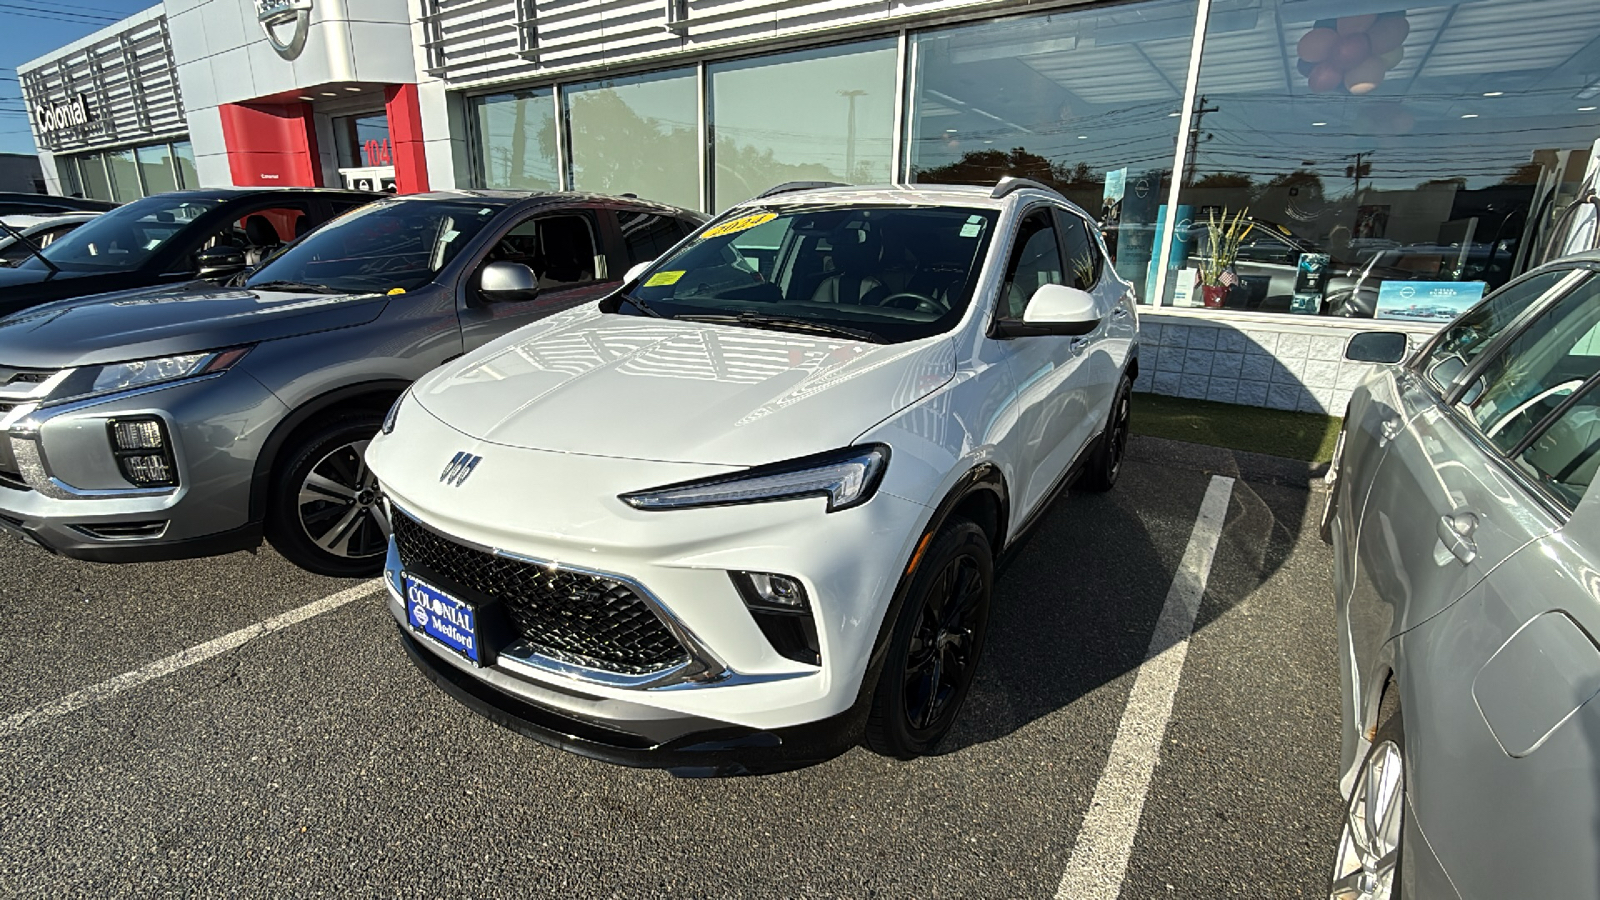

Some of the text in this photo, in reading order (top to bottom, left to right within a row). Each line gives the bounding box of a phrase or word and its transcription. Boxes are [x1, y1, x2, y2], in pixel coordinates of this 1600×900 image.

[36, 93, 88, 134] Colonial
[364, 138, 391, 167] 104
[709, 214, 768, 236] 2024
[408, 586, 474, 634] COLONIAL
[431, 615, 474, 650] Medford
